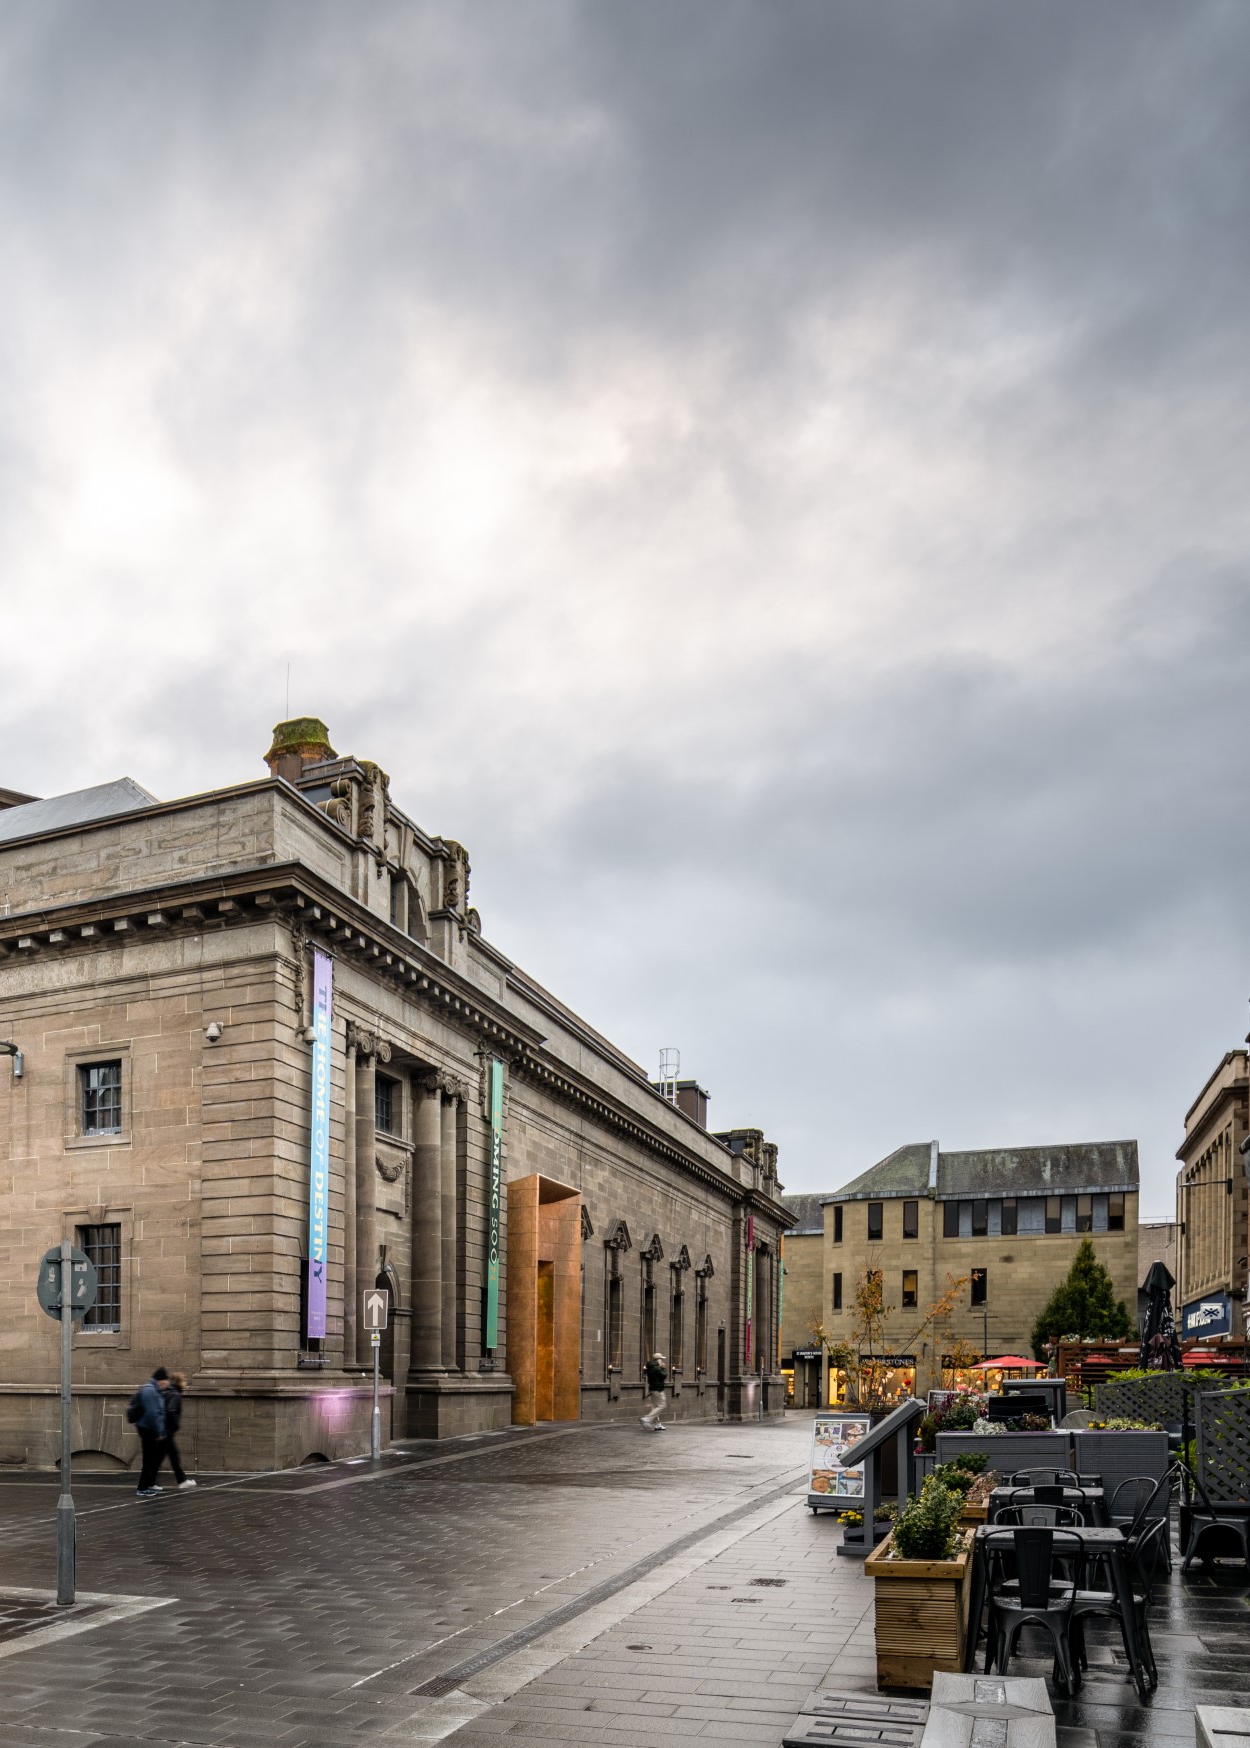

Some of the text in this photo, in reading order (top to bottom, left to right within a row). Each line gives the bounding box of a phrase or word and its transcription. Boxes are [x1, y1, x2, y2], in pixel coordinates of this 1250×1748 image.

[313, 986, 327, 1283] THE HOME OF DESTINY
